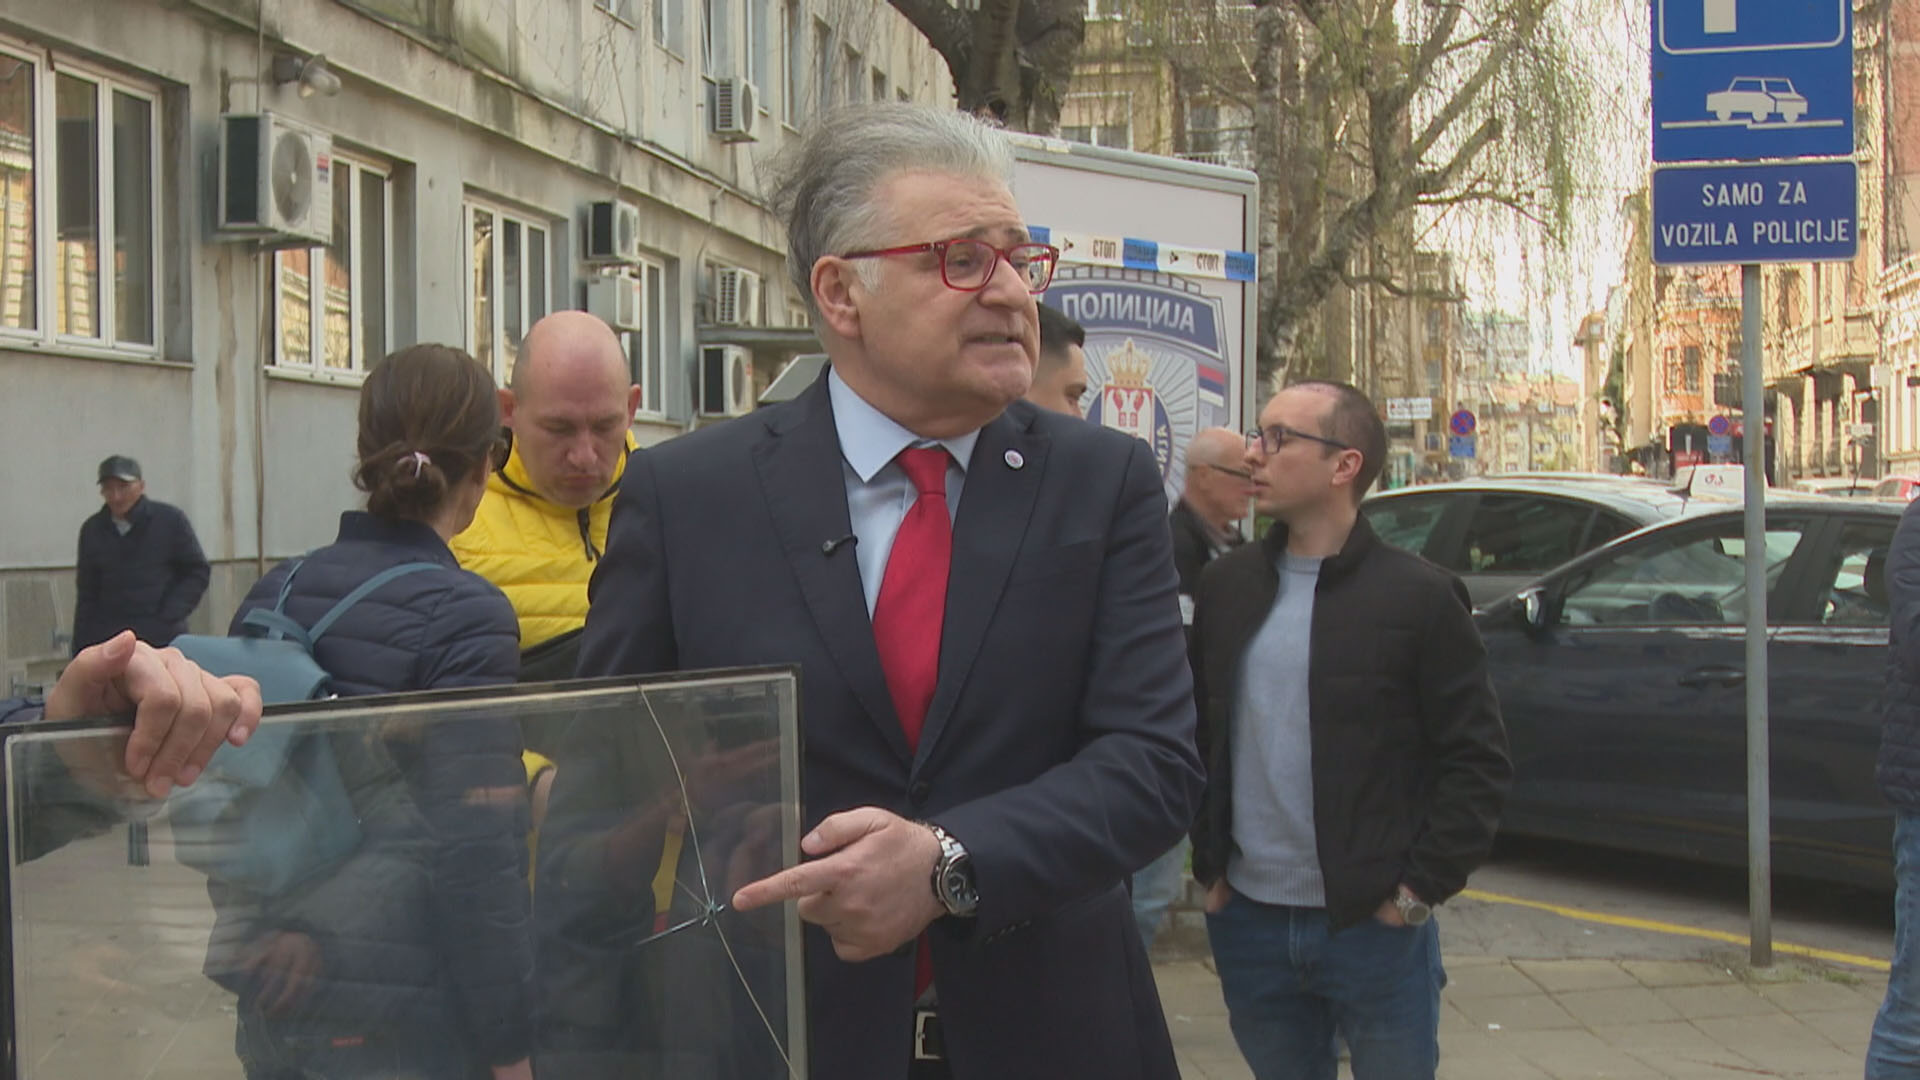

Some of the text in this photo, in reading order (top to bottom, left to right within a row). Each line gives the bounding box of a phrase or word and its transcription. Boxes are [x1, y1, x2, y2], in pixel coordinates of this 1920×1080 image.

[1702, 181, 1807, 207] SAMO ZA
[1661, 219, 1849, 247] VOZILA POLICIJE
[1092, 239, 1117, 260] СТОП
[1196, 253, 1219, 272] СТОП
[1061, 291, 1196, 335] ПОЛИЦИЈА
